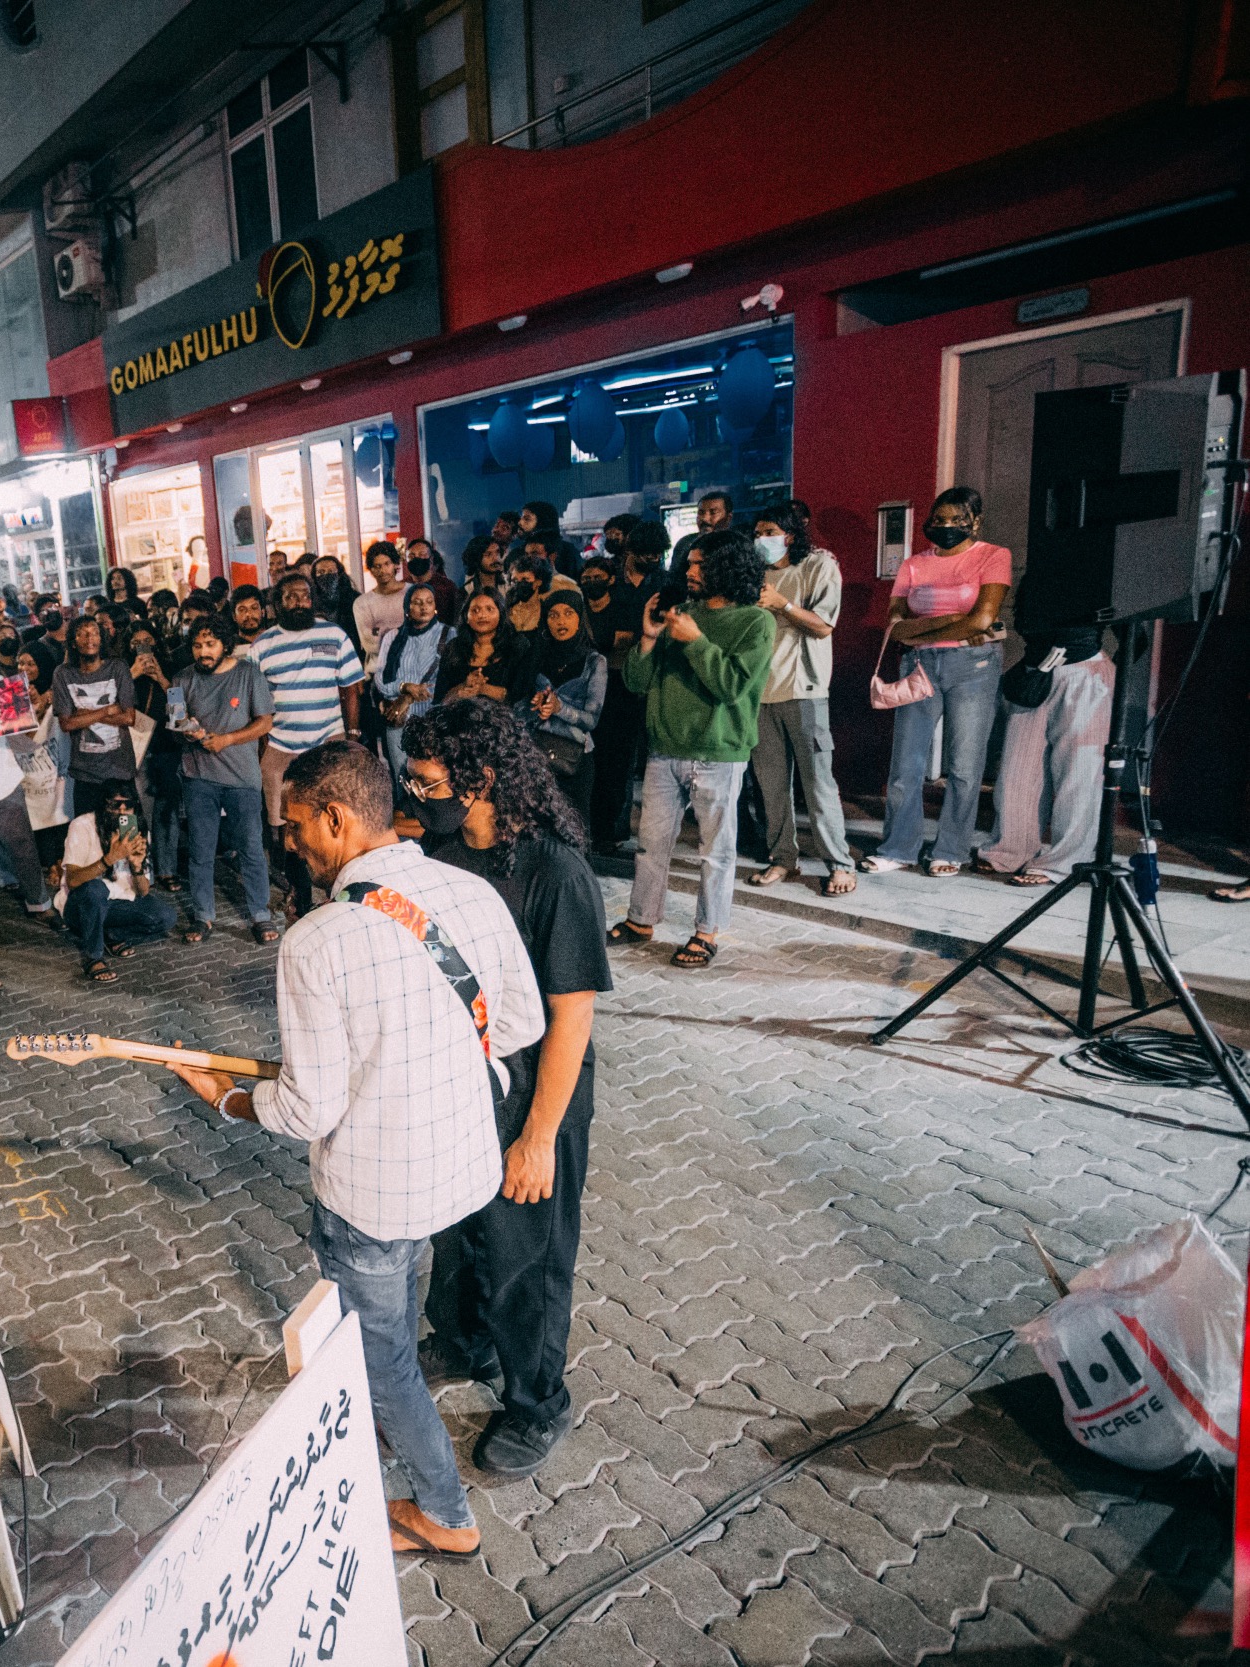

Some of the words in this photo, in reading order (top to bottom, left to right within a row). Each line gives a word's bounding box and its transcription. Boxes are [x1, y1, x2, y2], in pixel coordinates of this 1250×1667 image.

[110, 306, 258, 395] GOMAAFULHU
[289, 1589, 319, 1667] EFT
[318, 1478, 356, 1569] HER
[316, 1545, 360, 1661] DIE
